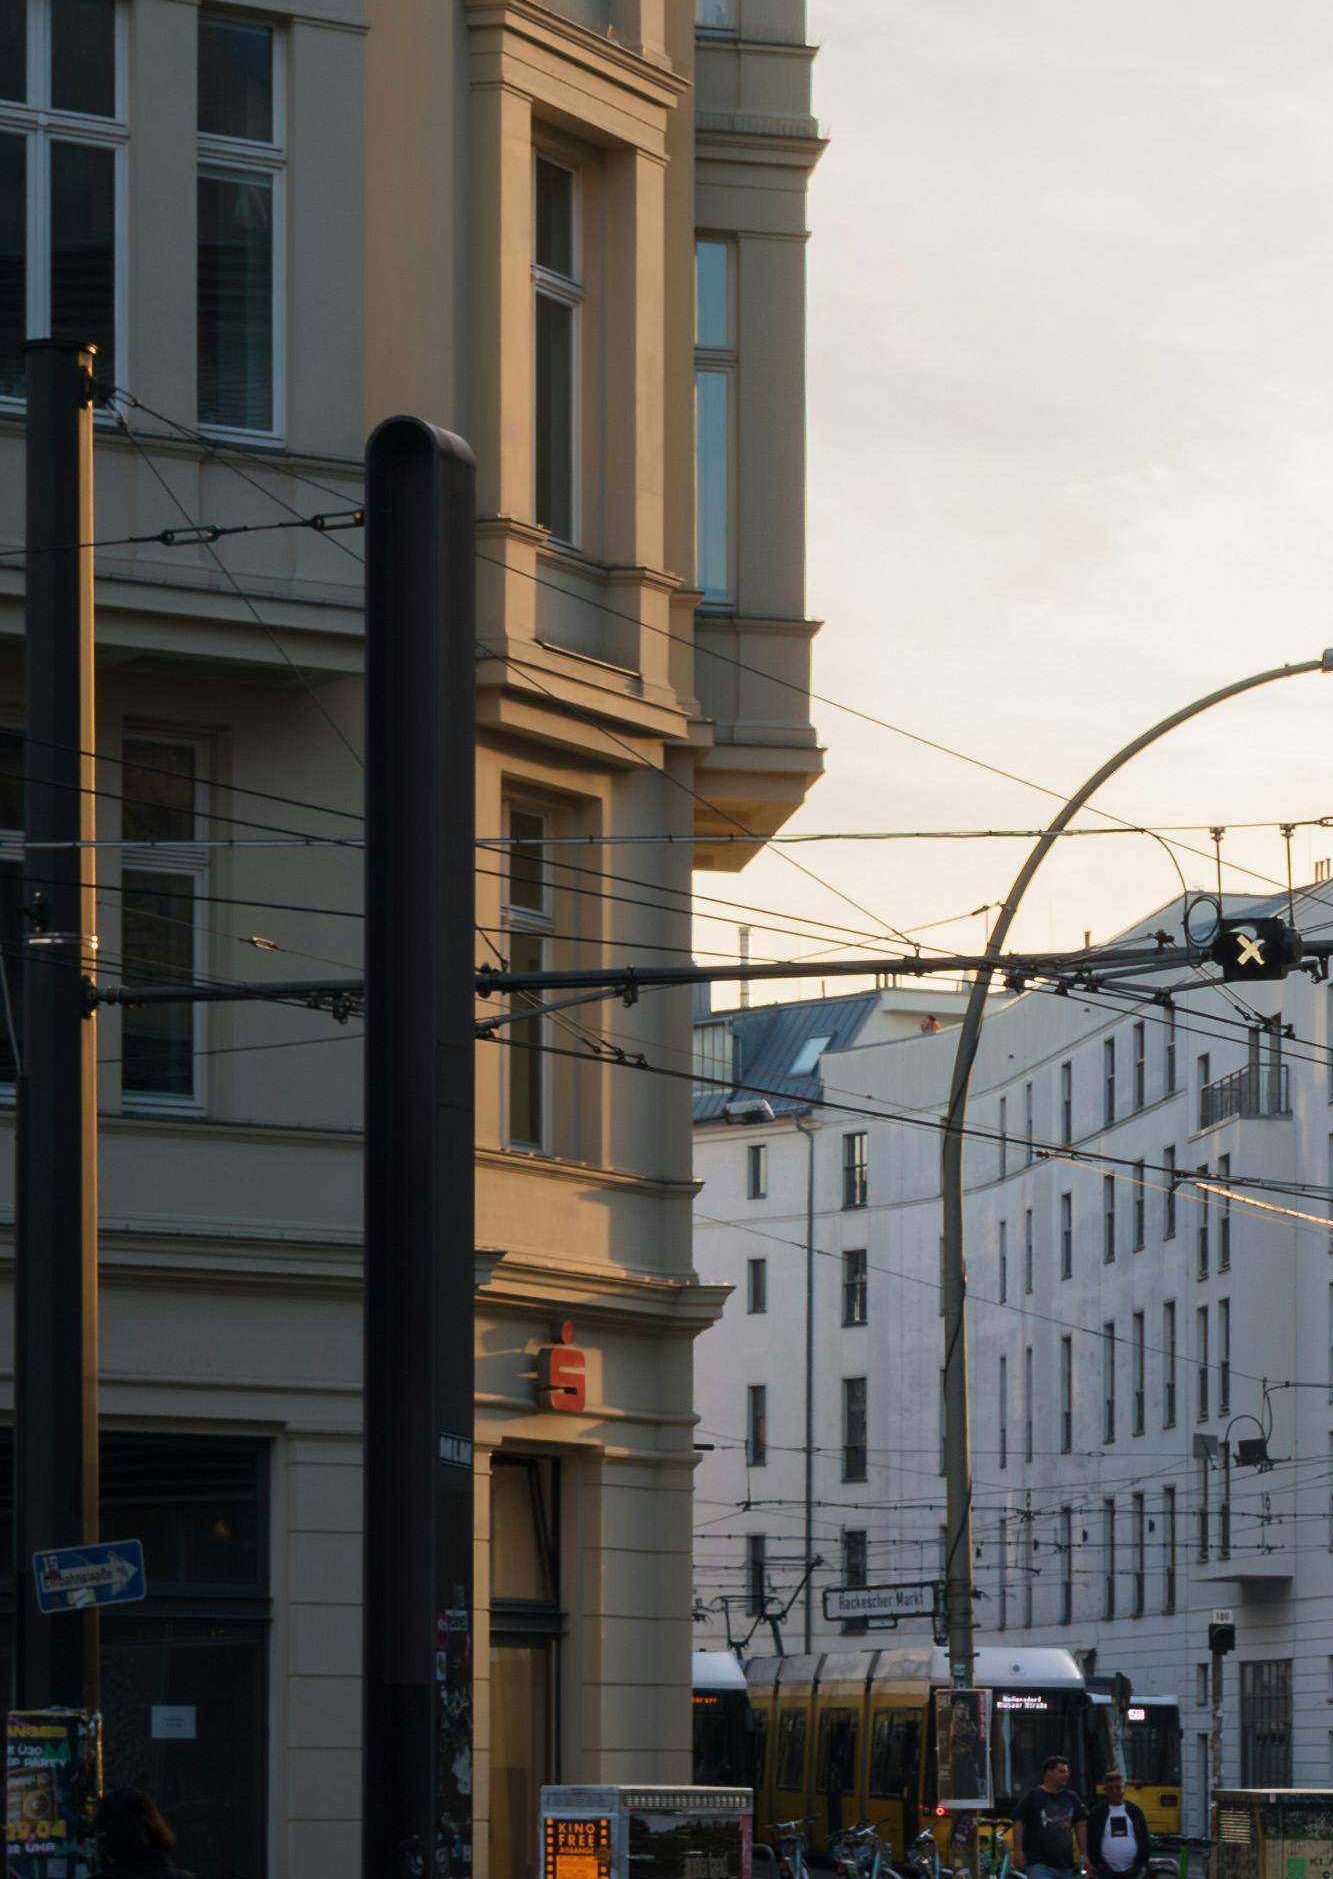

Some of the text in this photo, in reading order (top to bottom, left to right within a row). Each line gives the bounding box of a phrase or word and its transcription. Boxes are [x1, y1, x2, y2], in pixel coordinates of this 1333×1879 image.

[839, 1591, 924, 1610] Hackescher Markt
[558, 1823, 596, 1833] KINO
[558, 1834, 596, 1847] FREE
